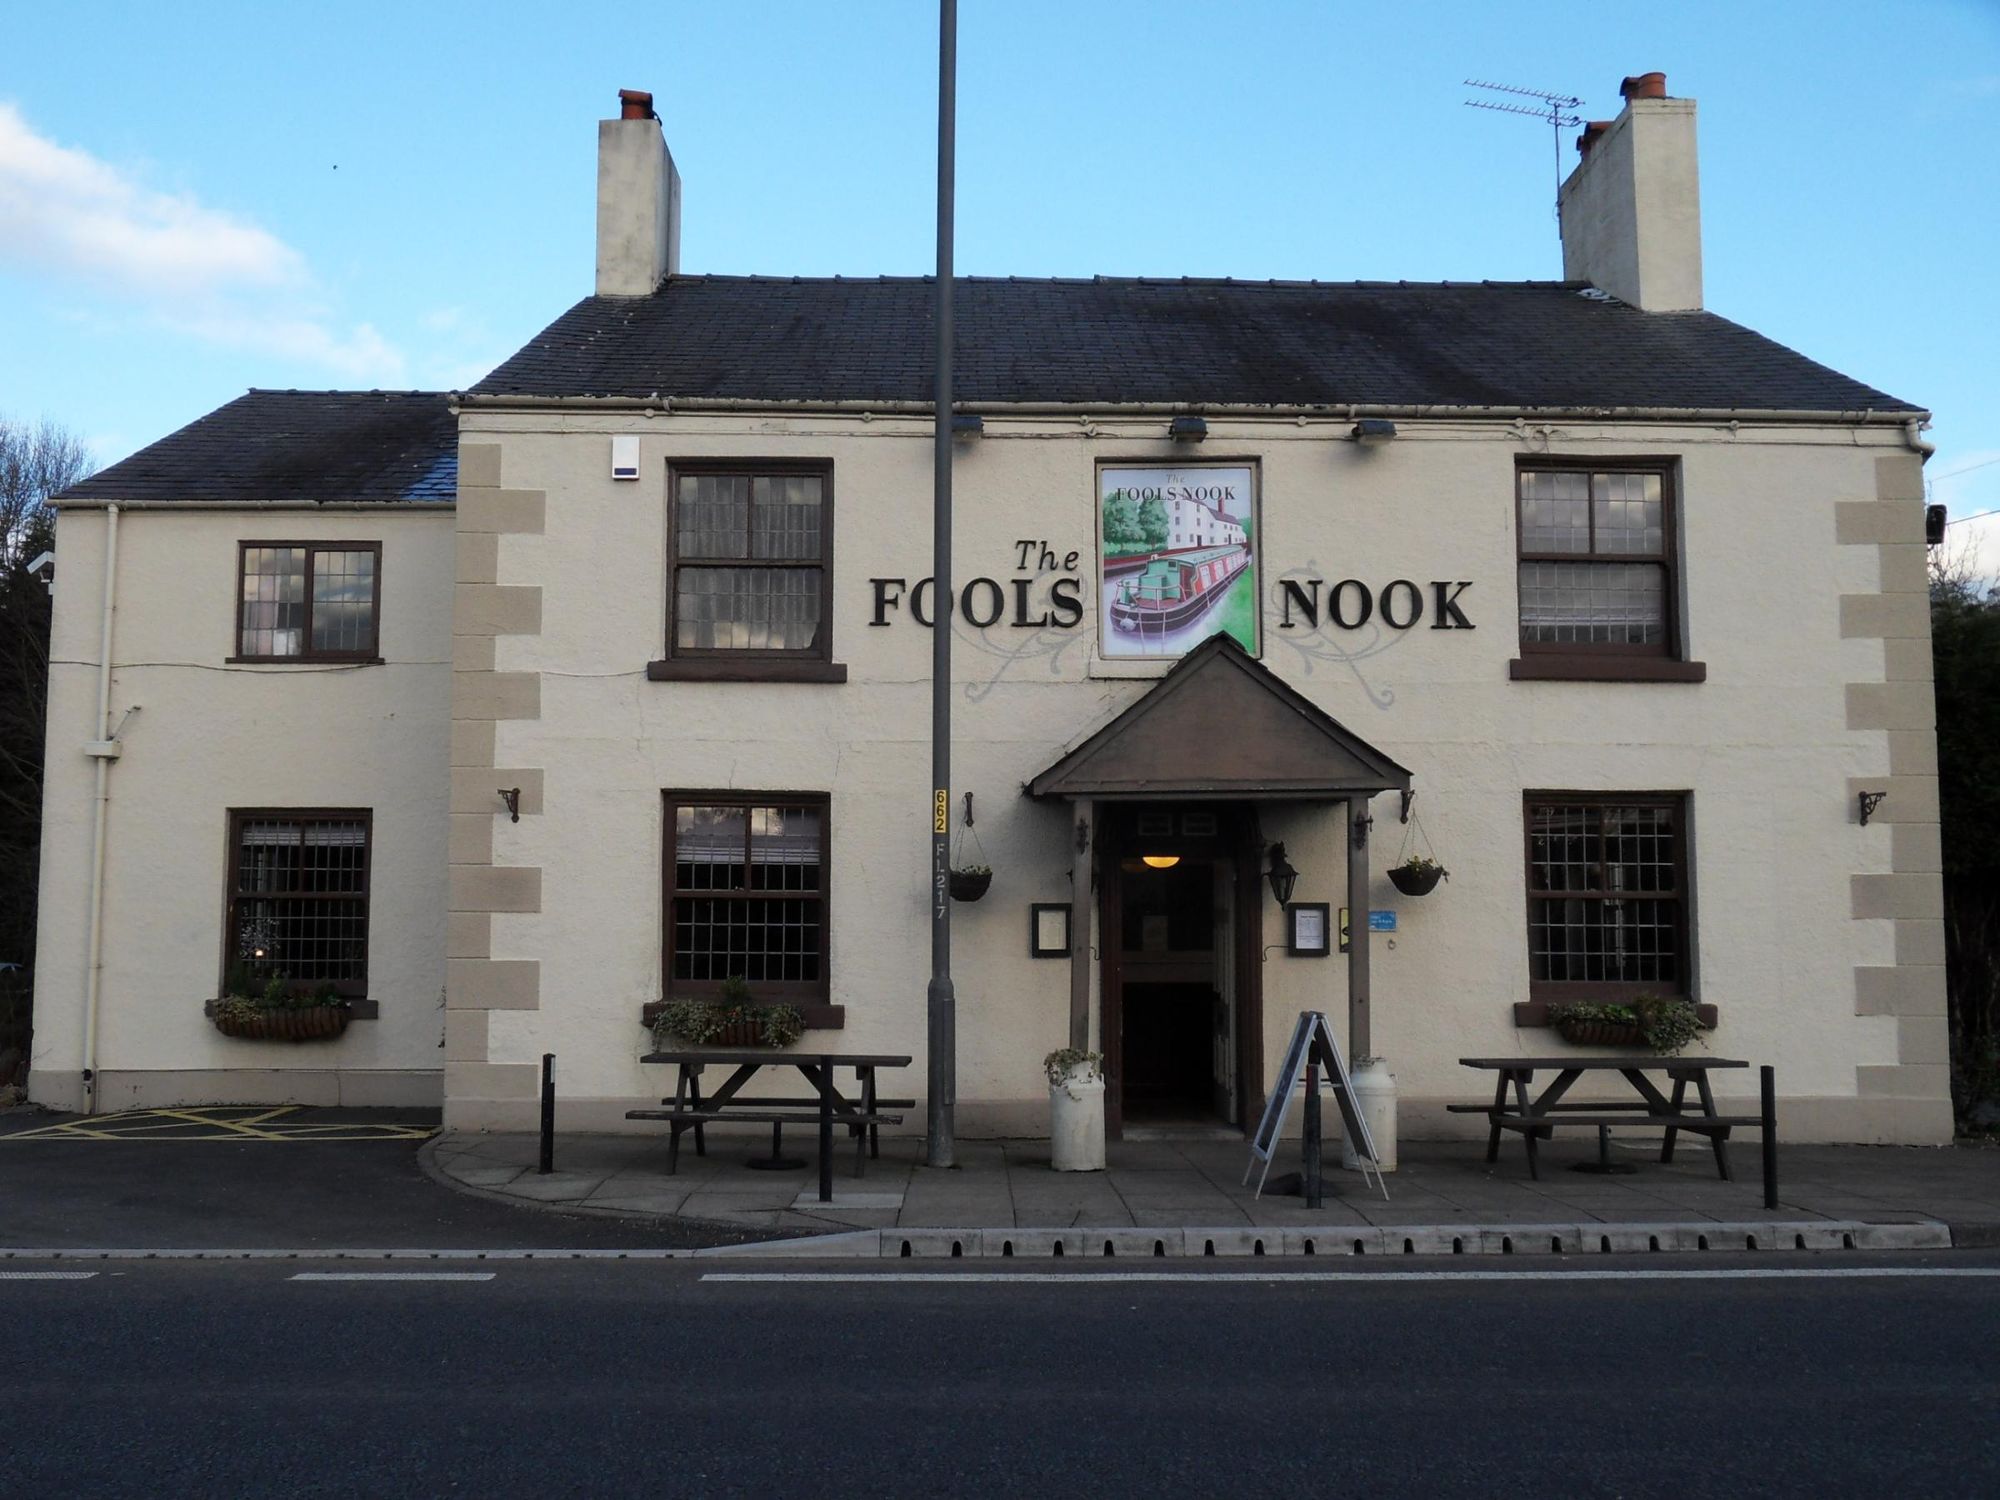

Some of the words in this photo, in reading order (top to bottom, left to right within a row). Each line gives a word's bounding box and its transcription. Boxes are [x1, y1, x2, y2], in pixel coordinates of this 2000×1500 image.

[1116, 487, 1178, 501] FOOLS
[1182, 487, 1236, 501] NOOK
[1166, 473, 1186, 484] The
[1015, 540, 1080, 572] The
[868, 577, 1084, 629] FOOLS
[1278, 579, 1476, 630] NOOK
[936, 790, 945, 831] 662
